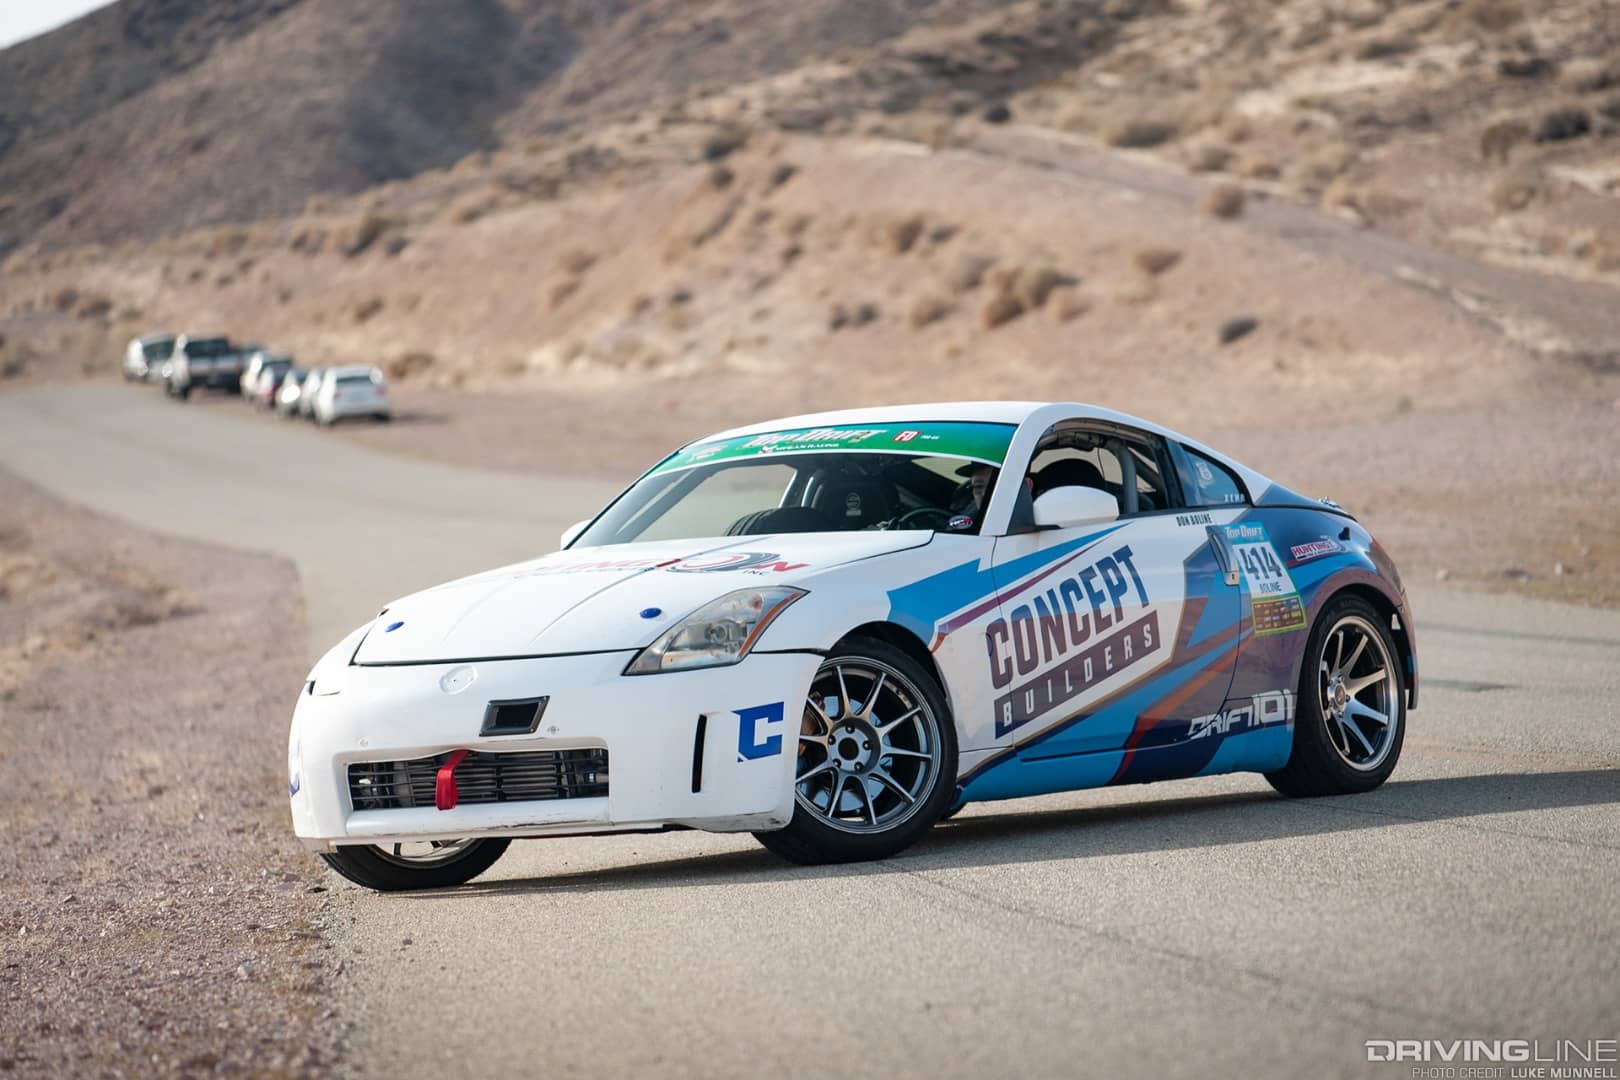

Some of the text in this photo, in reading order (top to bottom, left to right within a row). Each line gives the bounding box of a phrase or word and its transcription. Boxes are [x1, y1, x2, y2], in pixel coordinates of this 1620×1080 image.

[1239, 546, 1282, 580] 414
[986, 544, 1150, 690] CONCEPT
[1003, 623, 1153, 727] BUILDERS
[730, 701, 784, 761] C
